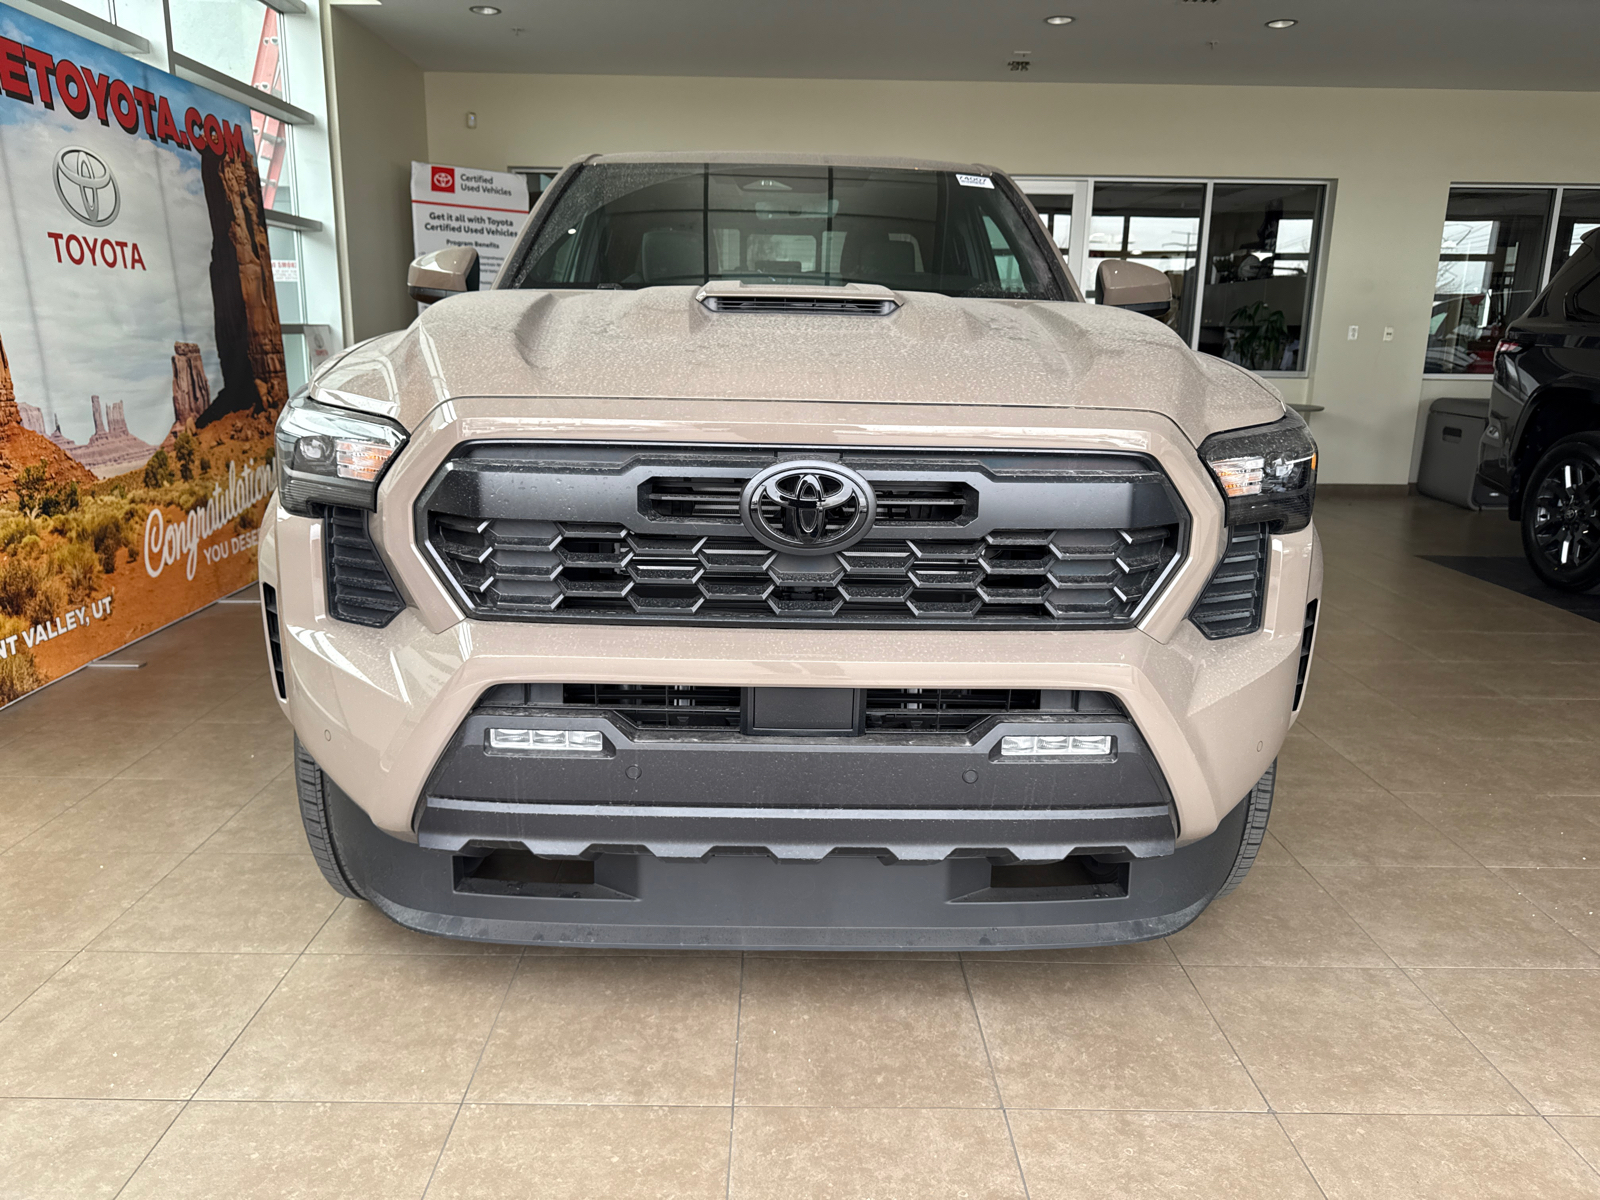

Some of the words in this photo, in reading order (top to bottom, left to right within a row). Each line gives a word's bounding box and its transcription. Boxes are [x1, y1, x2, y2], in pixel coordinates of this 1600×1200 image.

[460, 173, 494, 185] Certified
[460, 183, 481, 193] Used
[481, 185, 512, 197] Vehicles
[429, 211, 445, 221] Get
[446, 213, 454, 222] it
[455, 214, 466, 223] all
[467, 215, 486, 225] with
[487, 216, 514, 228] Toyota
[424, 222, 462, 233] Certified
[463, 225, 484, 235] Used
[485, 227, 518, 238] Vehicles
[47, 231, 147, 272] TOYOTA
[446, 238, 473, 248] Program
[474, 240, 500, 249] Benefits
[203, 541, 229, 565] YOU
[231, 527, 260, 555] DESE
[21, 606, 90, 649] VALLEY,
[91, 595, 112, 619] UT
